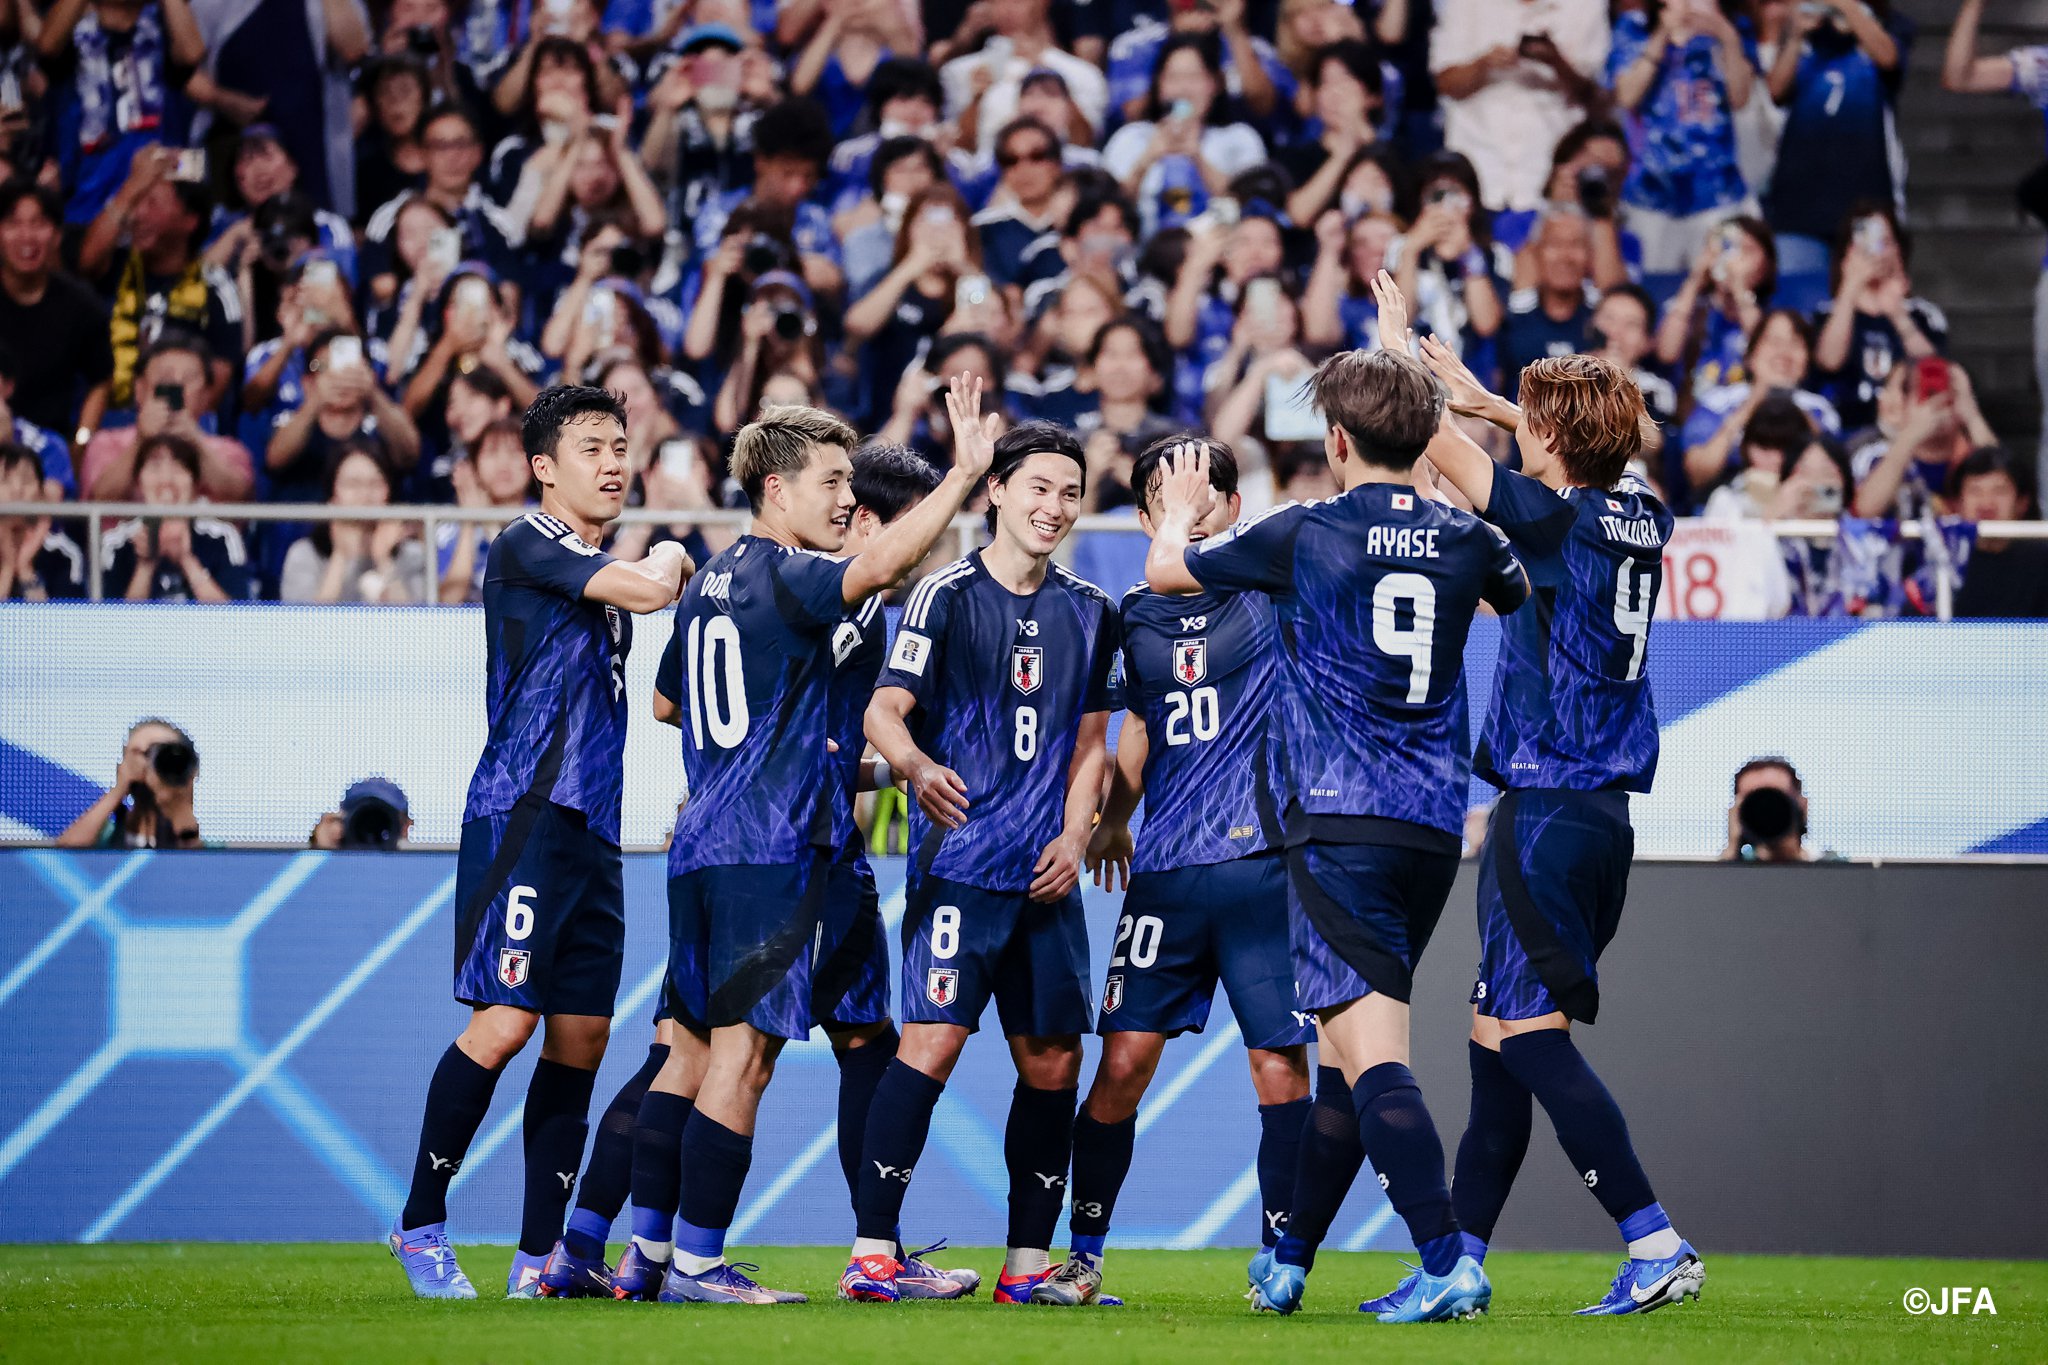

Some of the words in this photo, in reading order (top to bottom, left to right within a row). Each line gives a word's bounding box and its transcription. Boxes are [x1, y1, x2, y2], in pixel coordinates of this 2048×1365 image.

[1367, 526, 1439, 558] AYASE
[1662, 553, 1723, 621] 18
[1016, 618, 1039, 637] Y-3
[1180, 616, 1207, 632] Y-3
[1373, 573, 1436, 704] 9
[1614, 556, 1652, 681] 4
[687, 615, 749, 750] 10
[1014, 705, 1037, 762] 8
[1164, 686, 1220, 746] 20
[505, 885, 537, 941] 6
[930, 905, 961, 960] 8
[1110, 914, 1164, 969] 20
[873, 1159, 912, 1183] Y-3
